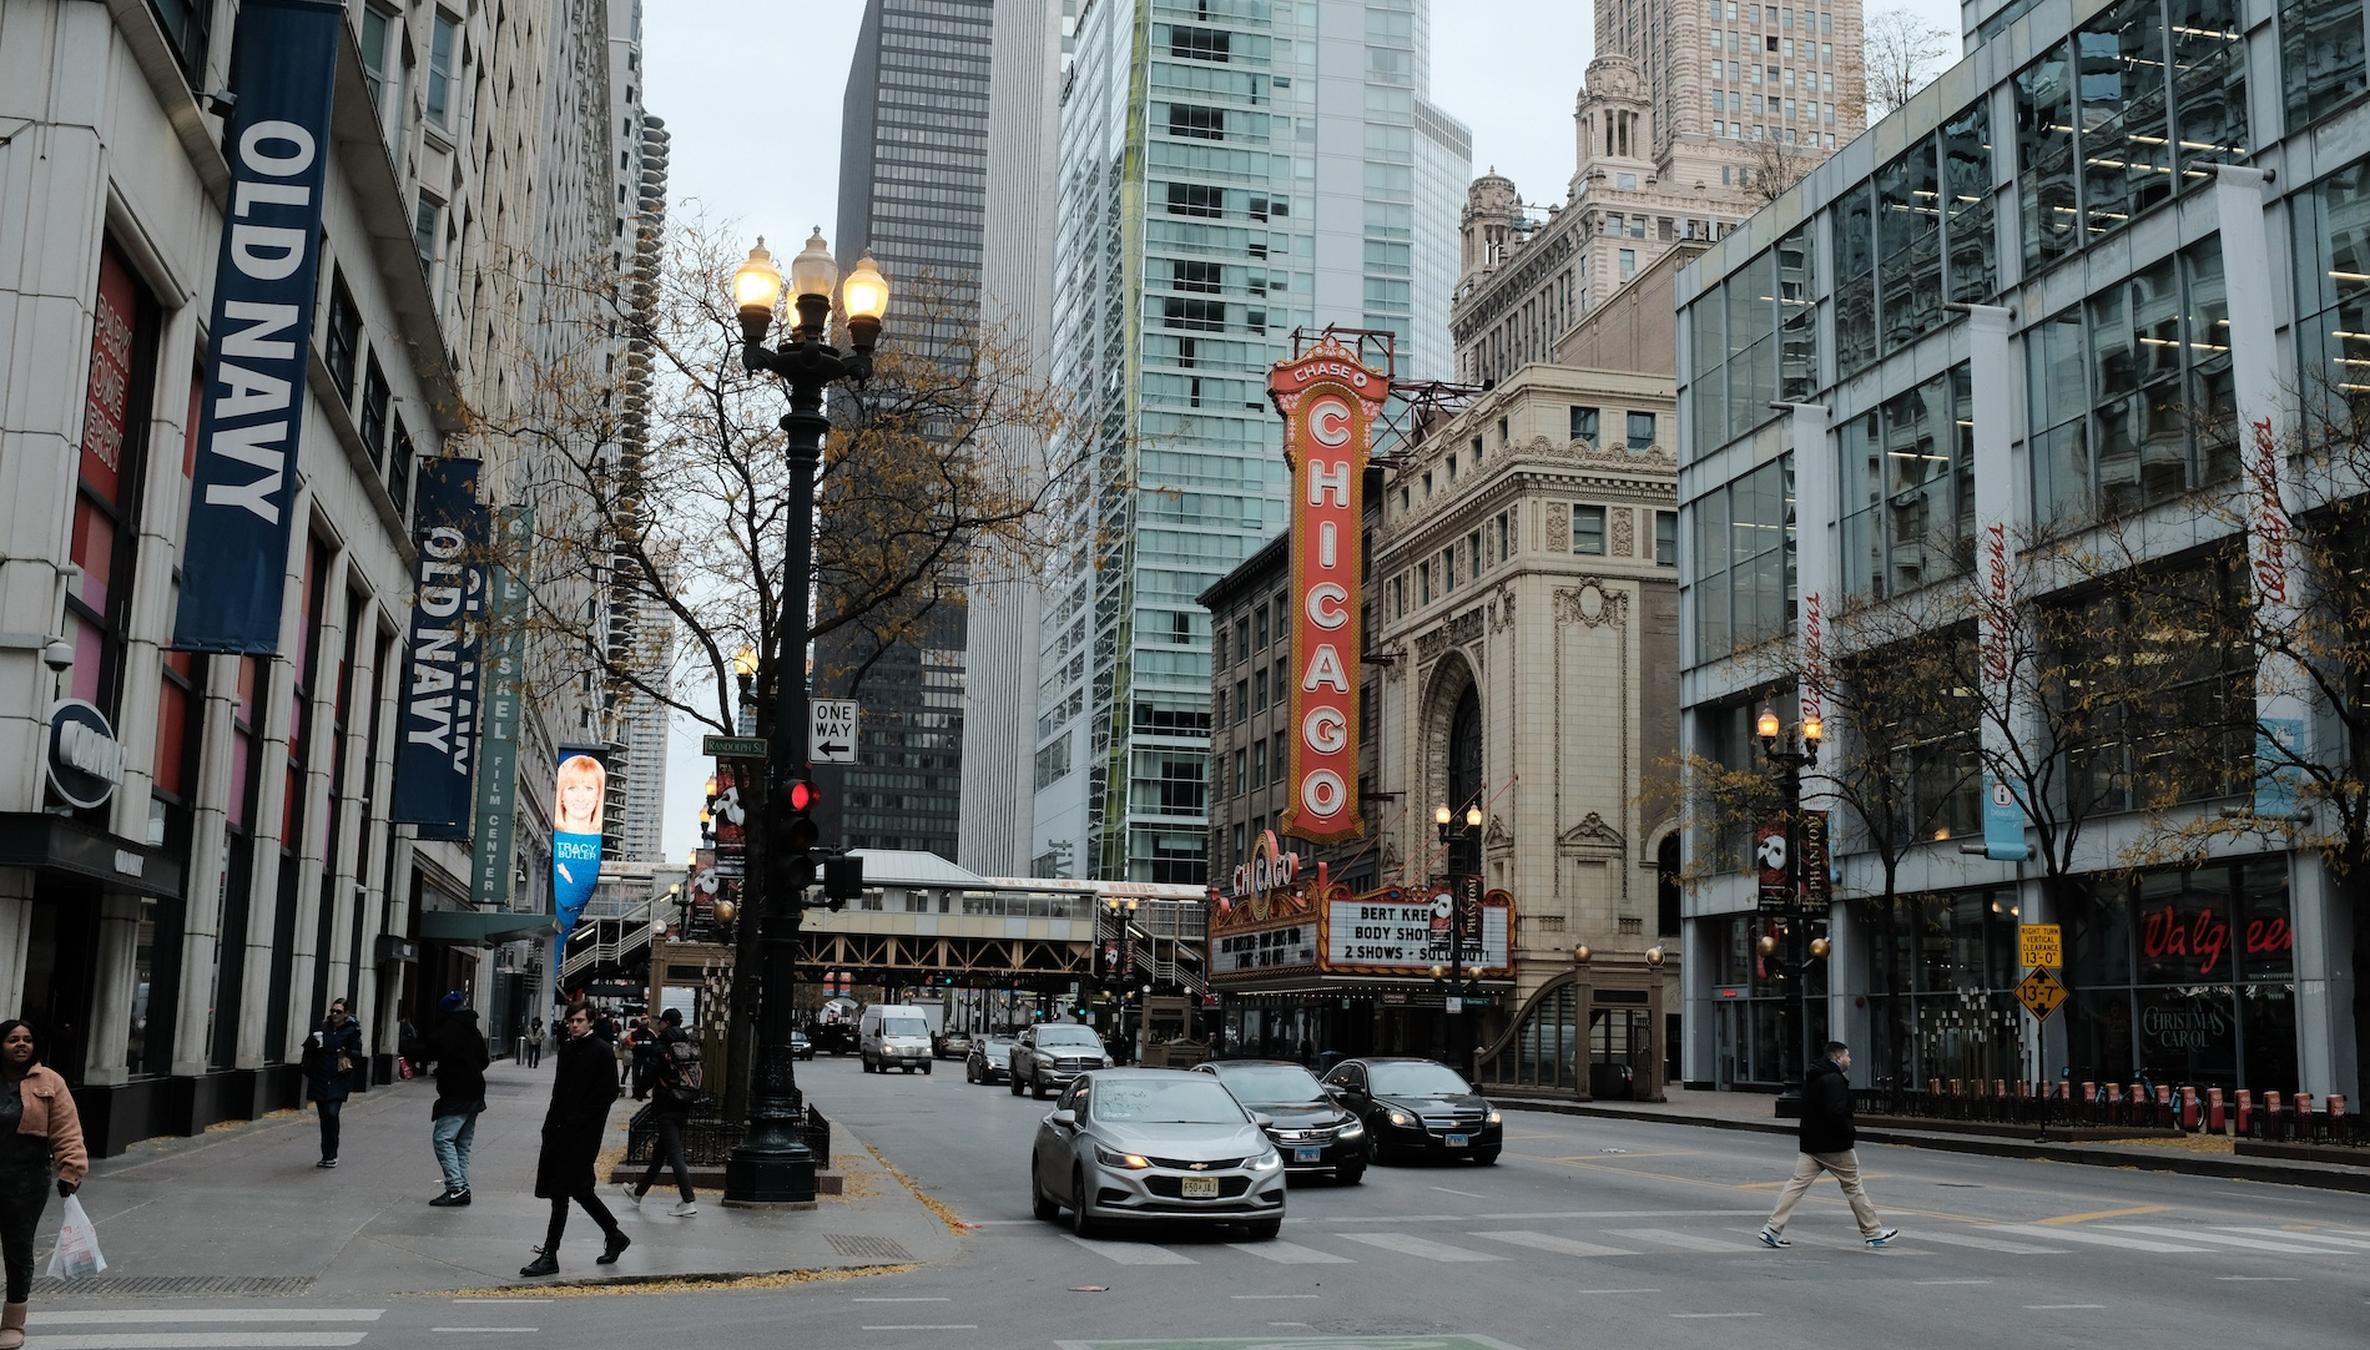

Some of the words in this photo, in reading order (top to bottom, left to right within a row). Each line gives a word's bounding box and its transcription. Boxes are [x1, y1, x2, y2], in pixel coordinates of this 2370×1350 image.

[231, 119, 316, 281] OLD
[95, 293, 133, 373] PARK
[1294, 364, 1352, 382] CHASE
[204, 300, 299, 526] NAVY
[420, 526, 464, 617] OLD
[1300, 400, 1351, 819] CHICAGO
[408, 628, 458, 754] NAVY
[817, 705, 852, 720] ONE
[816, 723, 852, 737] WAY
[708, 740, 751, 752] RANDOLPH
[489, 757, 503, 805] FILM
[484, 815, 499, 891] CENTER
[557, 842, 597, 854] TRACY
[558, 850, 596, 861] BUTLER
[1808, 815, 1821, 891] PHANTOM
[1233, 851, 1292, 897] CHICAGO
[1361, 907, 1395, 921] BERT
[1402, 908, 1429, 922] KRE
[1466, 879, 1477, 933] PHANTOM
[1355, 926, 1390, 940] BODY
[1396, 927, 1430, 941] SHOT
[2021, 927, 2040, 935] RIGHT
[2043, 927, 2058, 935] TURN
[1345, 945, 1352, 959] 2
[1357, 946, 1403, 960] SHOWS
[1419, 948, 1453, 961] SOLD
[2023, 944, 2058, 952] CLEARANCE
[2143, 1006, 2225, 1036] CHRISTMAS
[2161, 1030, 2209, 1048] CAROL
